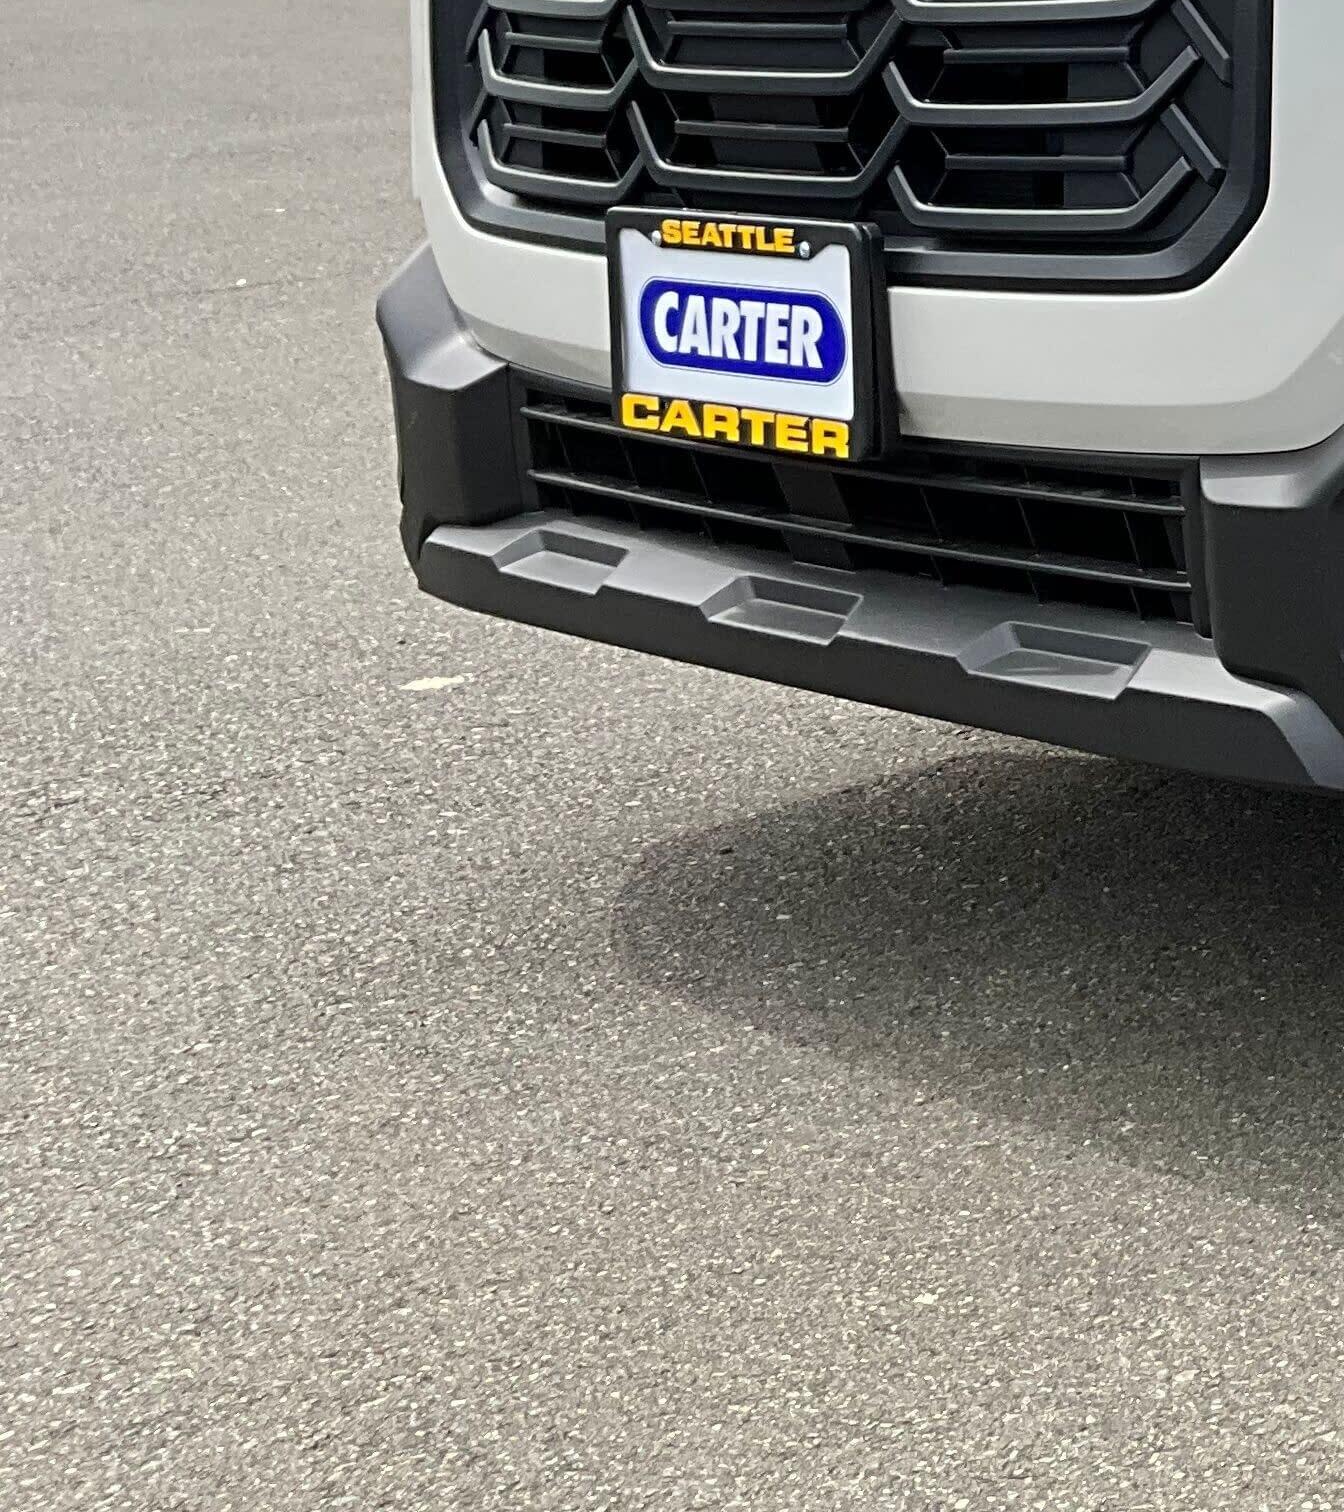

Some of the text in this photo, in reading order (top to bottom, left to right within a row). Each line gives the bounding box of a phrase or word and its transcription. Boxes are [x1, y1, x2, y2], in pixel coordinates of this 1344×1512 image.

[660, 219, 796, 255] SEATTLE
[653, 290, 824, 369] CARTER
[621, 392, 849, 459] CARTER
